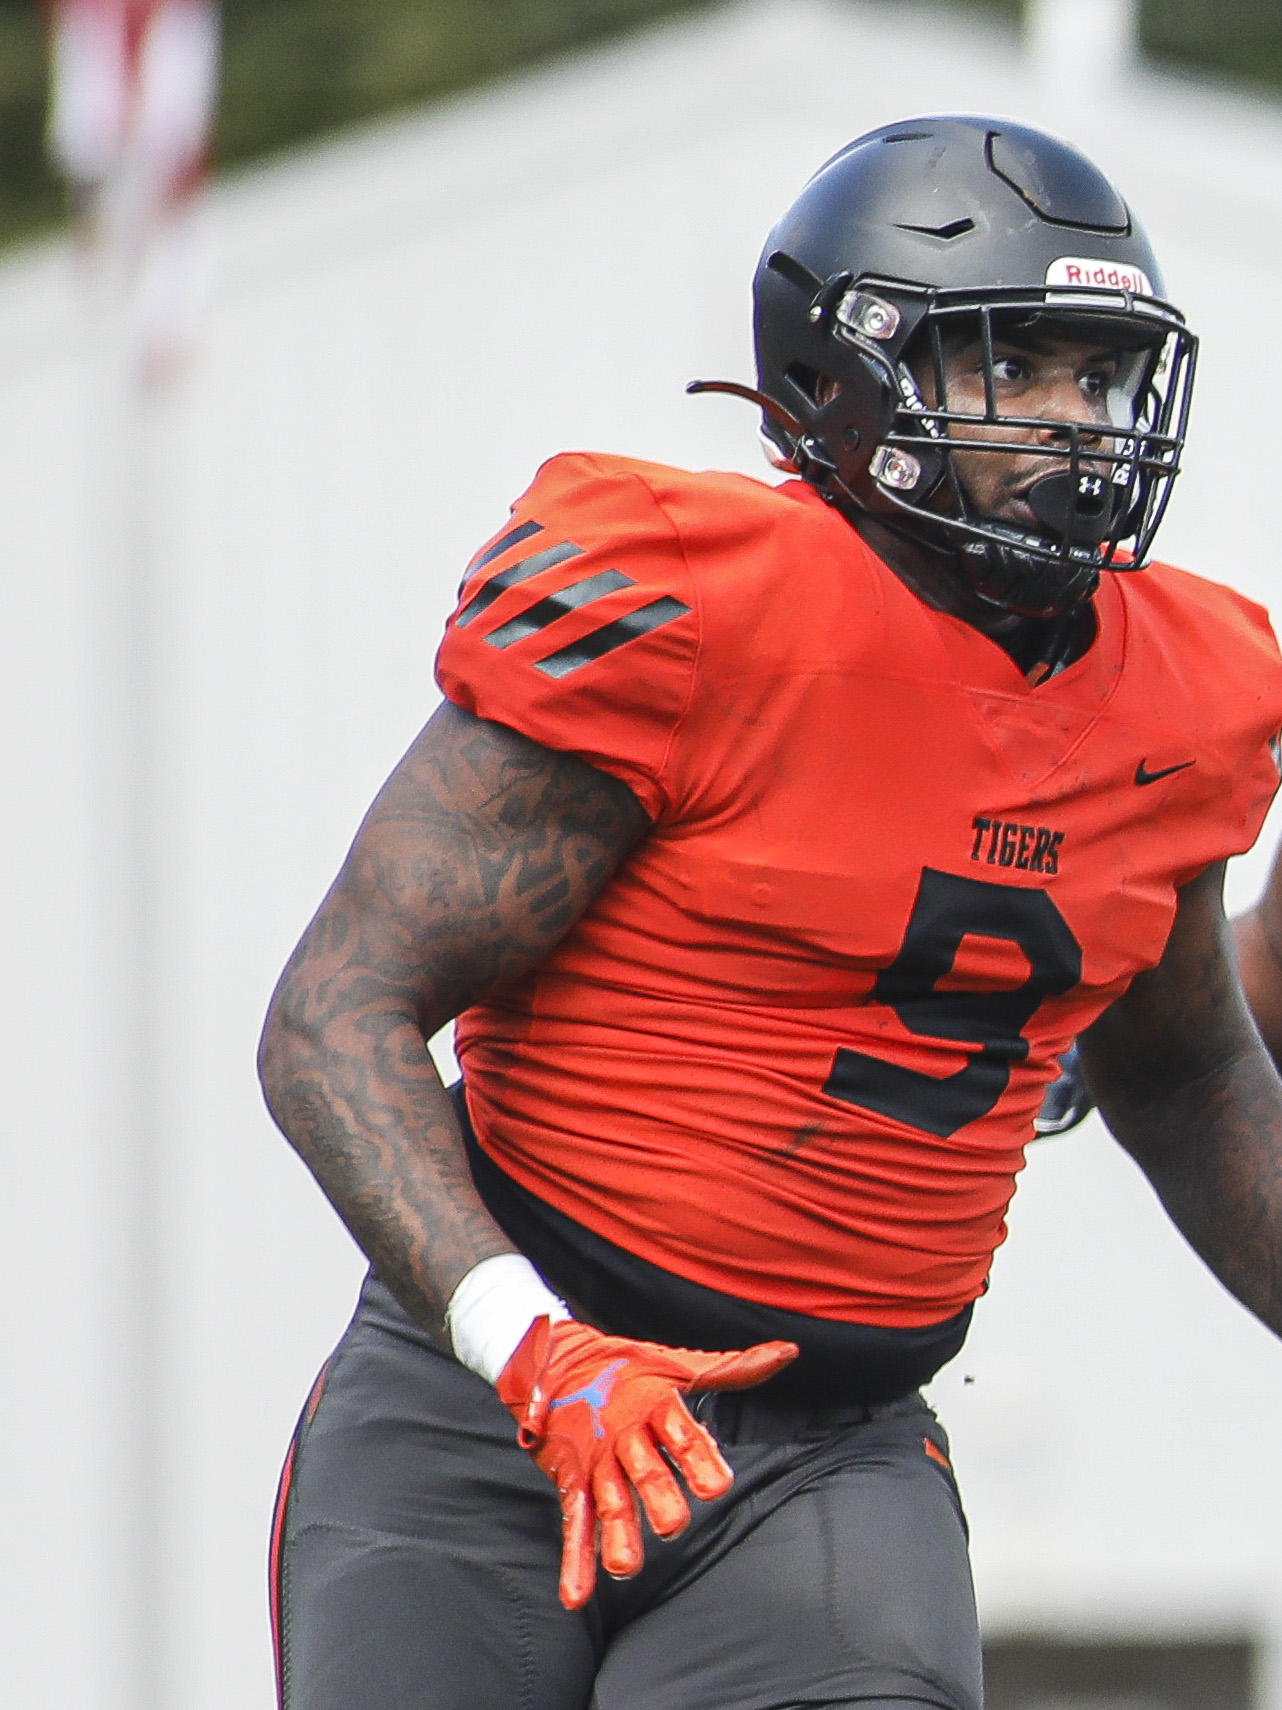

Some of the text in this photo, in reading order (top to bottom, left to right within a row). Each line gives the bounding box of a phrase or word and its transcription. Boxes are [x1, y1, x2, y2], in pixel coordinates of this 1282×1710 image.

[1066, 265, 1143, 294] Riddell
[971, 817, 1065, 875] TIGERS
[822, 866, 1082, 1138] 9
